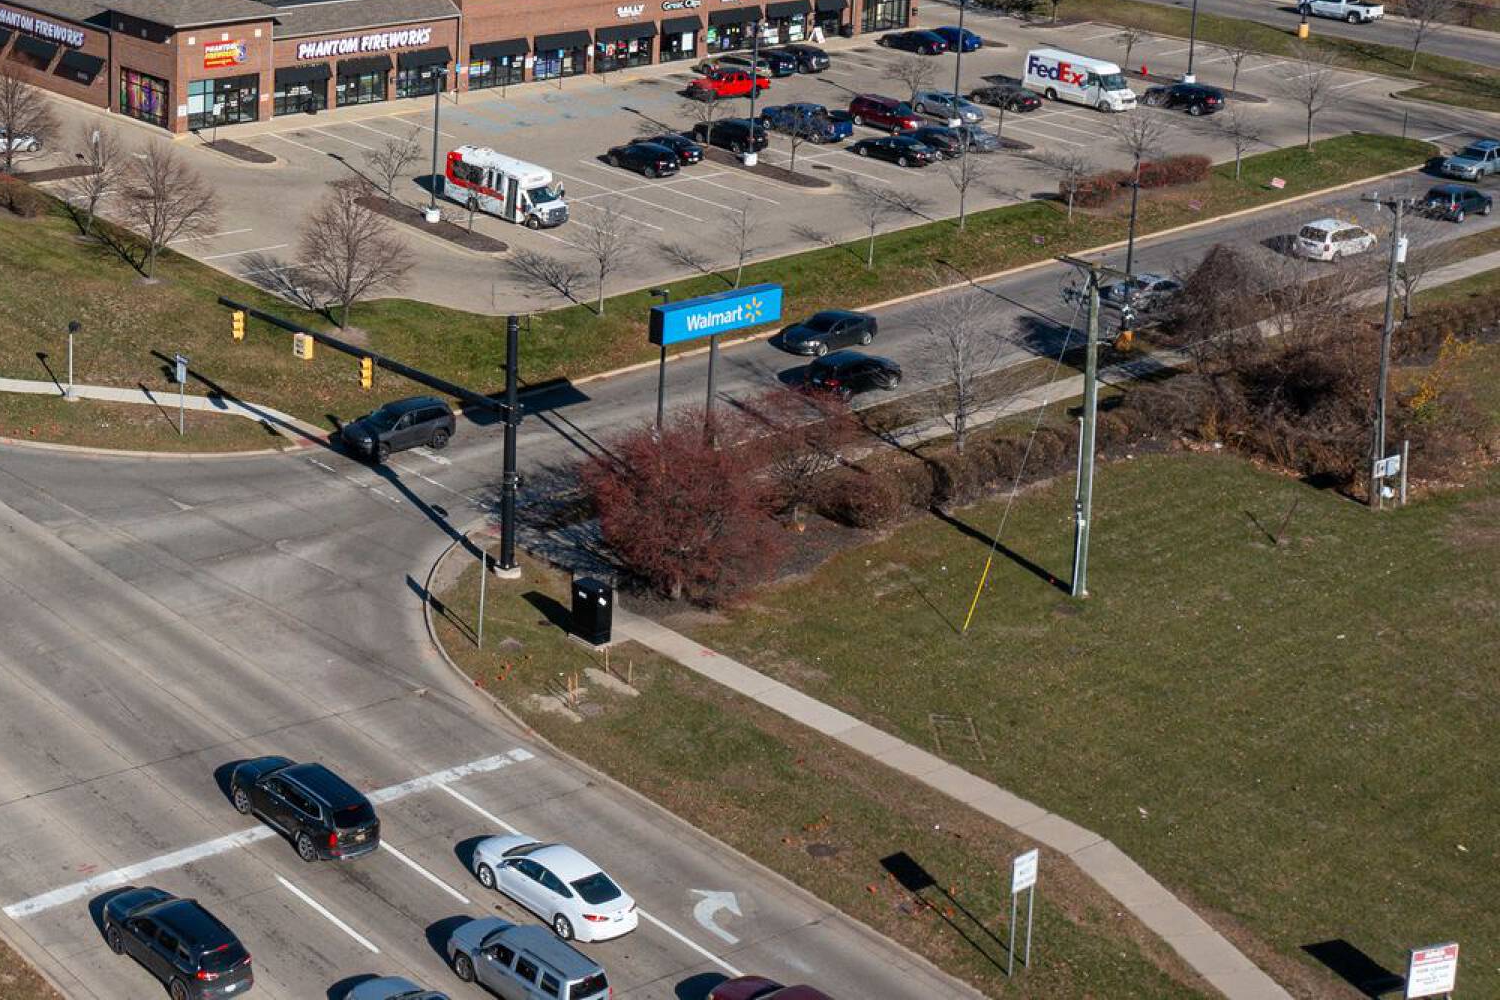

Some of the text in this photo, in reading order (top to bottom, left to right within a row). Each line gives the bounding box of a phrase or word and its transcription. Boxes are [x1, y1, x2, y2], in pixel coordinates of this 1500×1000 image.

[35, 19, 85, 47] FIREWORKS
[298, 28, 432, 59] PHANTOM FIREWORKS
[1028, 55, 1085, 87] FedEx
[686, 304, 744, 332] Walmart
